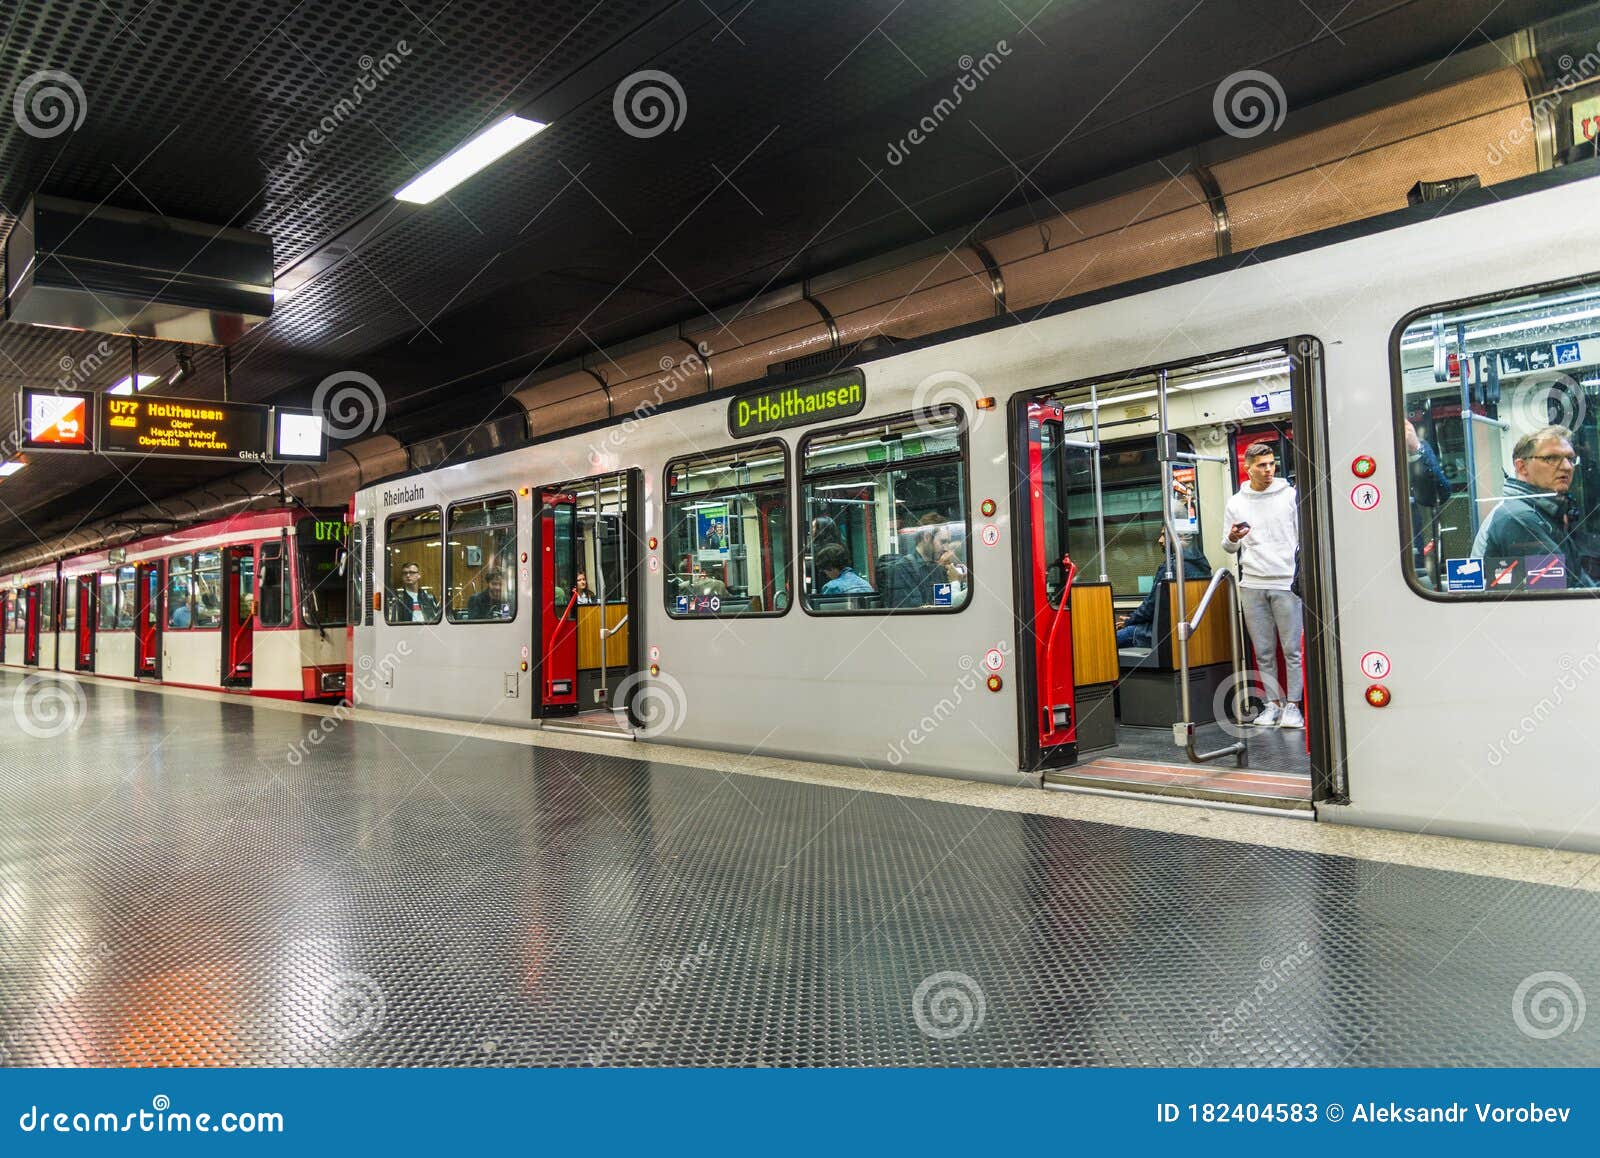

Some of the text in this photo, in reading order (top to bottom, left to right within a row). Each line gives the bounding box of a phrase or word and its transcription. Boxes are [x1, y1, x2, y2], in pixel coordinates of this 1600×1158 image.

[110, 400, 224, 420] U77 Holthausen
[739, 384, 860, 427] D-Holthausen
[239, 450, 259, 460] Gleis
[383, 484, 424, 507] Rheinbahn
[315, 521, 342, 541] U77
